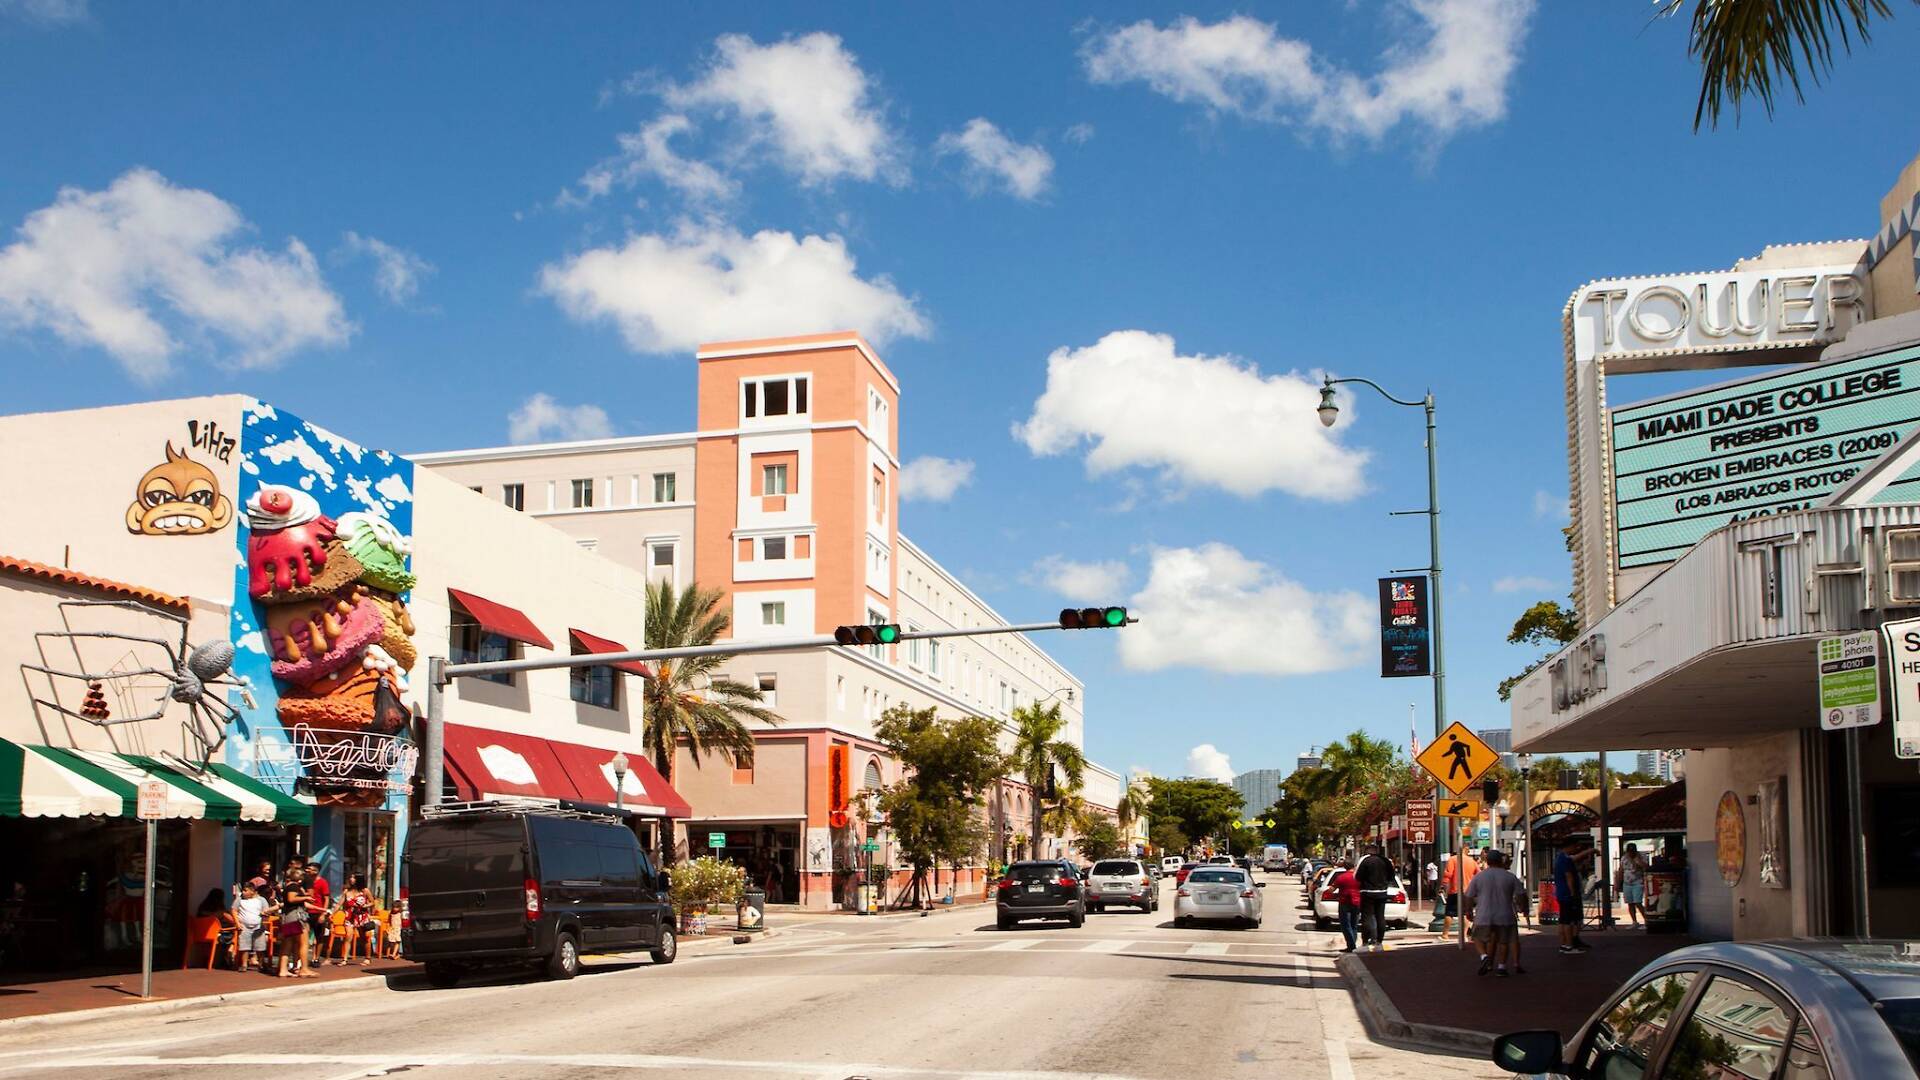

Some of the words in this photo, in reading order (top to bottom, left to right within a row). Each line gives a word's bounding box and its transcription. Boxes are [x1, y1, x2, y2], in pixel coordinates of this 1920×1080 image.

[1587, 273, 1865, 345] TOWER
[1638, 410, 1702, 441] MIAMI
[1708, 396, 1774, 426] DADE
[1779, 368, 1901, 411] COLLEGE
[1710, 416, 1819, 451] PRESENTS
[1645, 465, 1720, 492] BROKEN
[1725, 444, 1833, 477] EMBRACES
[1838, 431, 1899, 459] (2009)
[1675, 495, 1711, 513] (LOS
[1714, 481, 1791, 505] ABRAZOS
[1841, 658, 1865, 670] 40101
[1844, 643, 1873, 658] phone
